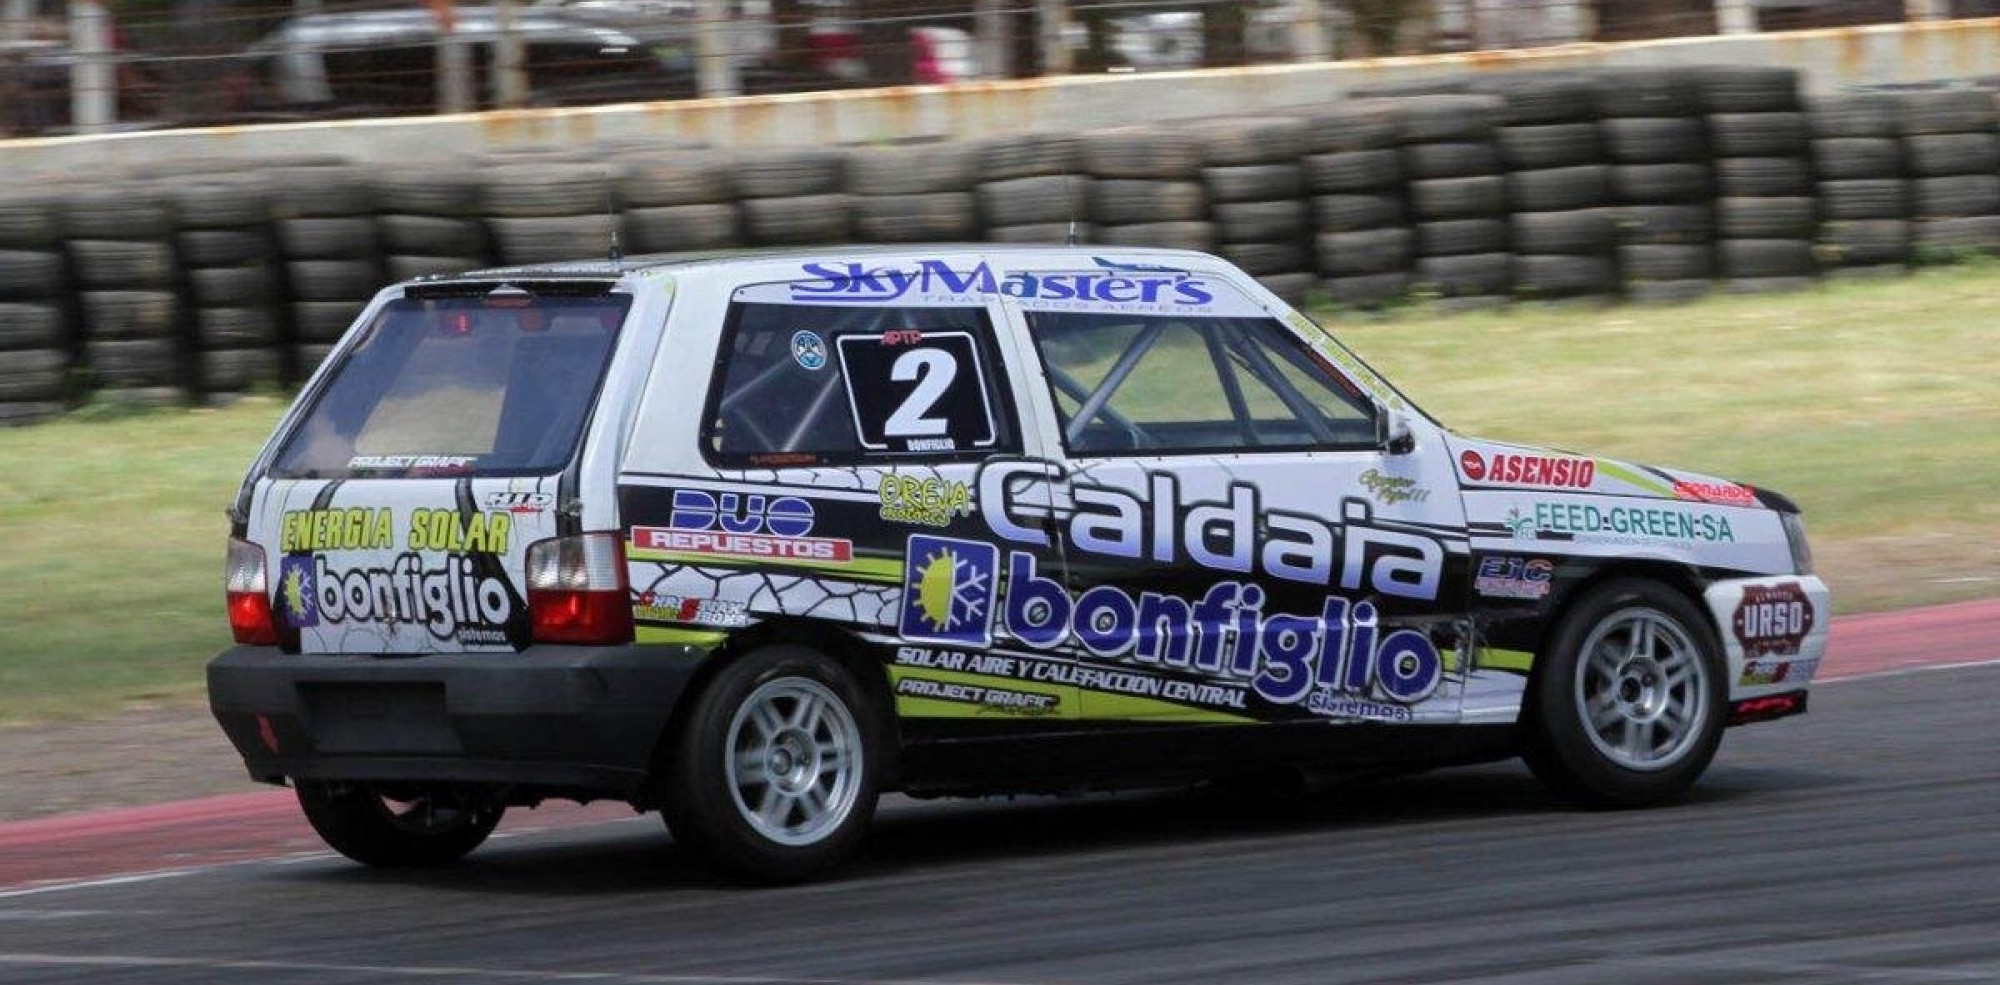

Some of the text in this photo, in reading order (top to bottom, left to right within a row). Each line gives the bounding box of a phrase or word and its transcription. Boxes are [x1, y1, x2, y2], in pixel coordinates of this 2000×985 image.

[884, 348, 958, 436] 2
[879, 472, 969, 518] OREJA
[1488, 454, 1595, 489] ASENSIO
[280, 508, 511, 556] ENERGIA SOLAR
[669, 489, 814, 538] DUO
[979, 456, 1445, 602] Caldaia
[650, 530, 834, 559] REPUESTOS
[314, 552, 512, 642] bonfiglio
[1006, 552, 1442, 704] bonfiglio
[896, 646, 1247, 709] SOLAR AIRE Y CALEFACCION CENTRAL
[898, 678, 986, 702] PROJECT
[1307, 691, 1414, 721] sistemas
